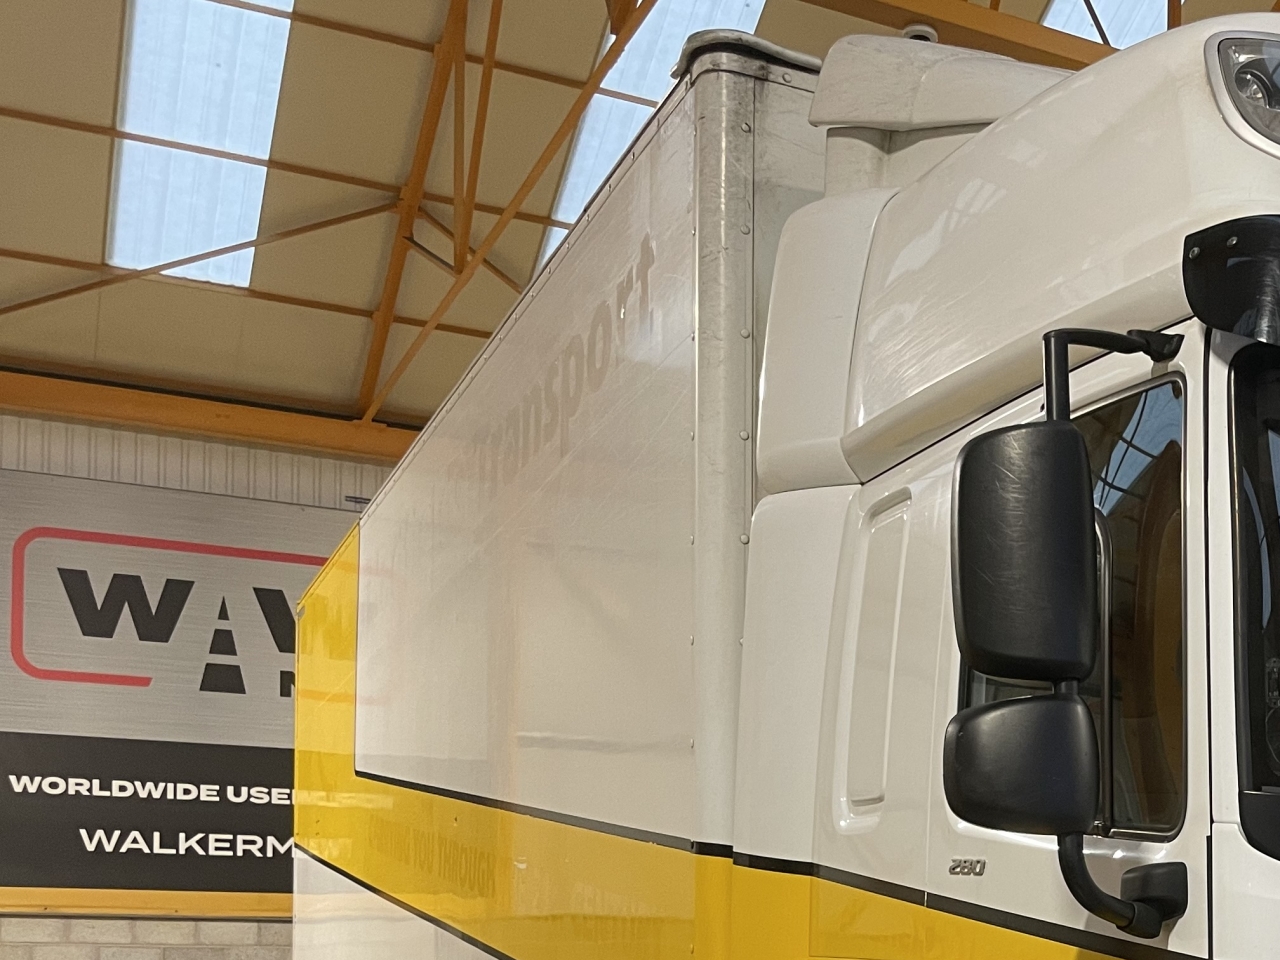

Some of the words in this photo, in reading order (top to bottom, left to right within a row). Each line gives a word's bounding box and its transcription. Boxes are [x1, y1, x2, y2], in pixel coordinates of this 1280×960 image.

[8, 774, 219, 802] WORLDWIDE
[226, 785, 295, 805] USE
[949, 858, 987, 877] 280
